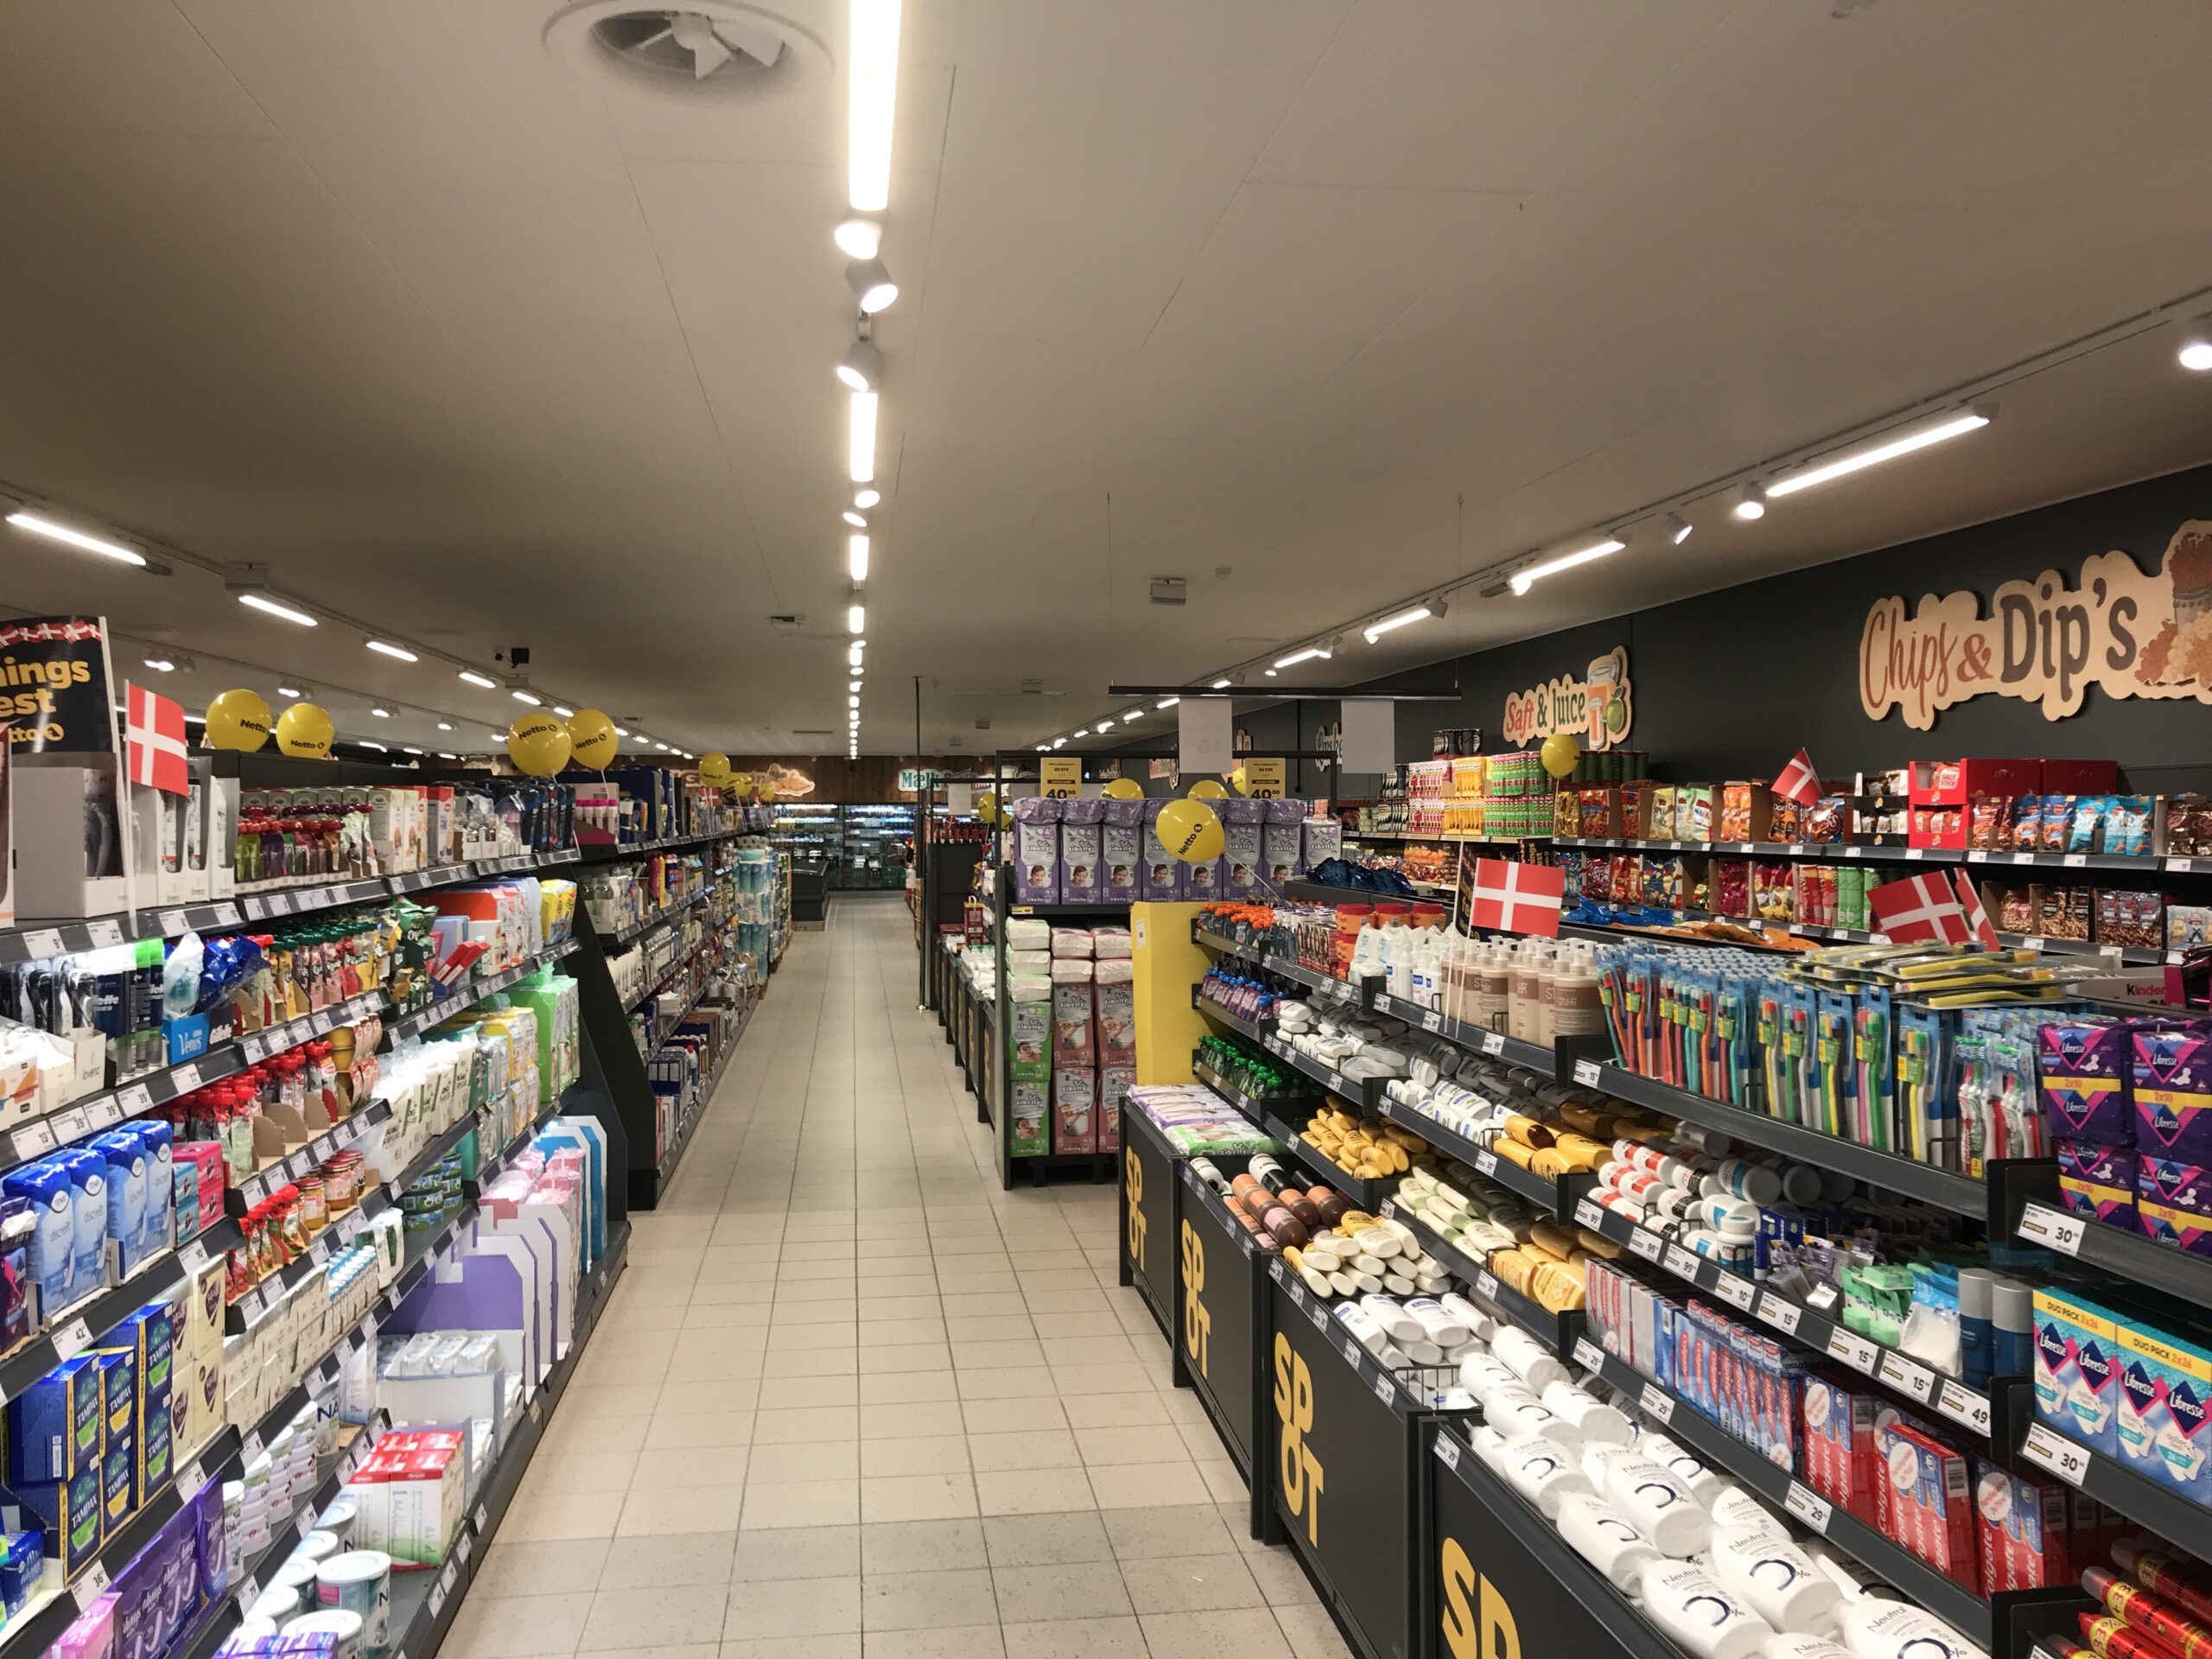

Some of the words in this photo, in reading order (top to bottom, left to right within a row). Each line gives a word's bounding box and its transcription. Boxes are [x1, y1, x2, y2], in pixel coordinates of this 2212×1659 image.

[1865, 607, 1958, 718] Chips
[1956, 632, 1993, 683] &
[1999, 577, 2138, 702] Dip's
[0, 657, 90, 689] ings
[1507, 698, 1534, 738] Saft
[1537, 693, 1547, 728] &
[1551, 684, 1586, 734] Juice
[240, 719, 267, 734] Netto
[518, 725, 547, 740] Netto
[10, 727, 41, 743] tto
[575, 736, 599, 750] Netto
[290, 740, 315, 749] Netto
[1046, 789, 1067, 799] 40
[1250, 789, 1272, 799] 40
[1178, 832, 1198, 855] Netto
[2126, 983, 2165, 995] Kinder
[179, 1033, 201, 1055] Venus
[2062, 1043, 2085, 1053] Libresse
[2152, 1054, 2177, 1066] Libresse
[2066, 1102, 2088, 1113] Libresse
[2155, 1116, 2179, 1129] Libresse
[2158, 1168, 2182, 1185] Libresse
[2056, 1227, 2072, 1243] 30
[1783, 1313, 1793, 1325] 15
[2048, 1301, 2062, 1314] DUO
[2063, 1308, 2081, 1322] PACK
[2081, 1315, 2100, 1330] 2x26
[76, 1328, 86, 1340] 42
[2039, 1332, 2067, 1357] Libresse
[1859, 1350, 1869, 1363] 15
[2133, 1338, 2149, 1351] DUO
[2150, 1344, 2171, 1359] PACK
[2171, 1354, 2192, 1369] 2x26
[2079, 1350, 2110, 1376] Libresse
[1913, 1376, 1925, 1392] 15
[2124, 1371, 2155, 1397] Libresse
[2171, 1392, 2204, 1419] Libresse
[1973, 1408, 1987, 1424] 49
[2060, 1453, 2077, 1471] 30
[1811, 1507, 1823, 1522] 29
[1728, 1532, 1769, 1552] Neutral
[92, 1574, 105, 1588] 36
[1662, 1568, 1702, 1586] Neutral
[1866, 1605, 1908, 1632] Neutral
[1794, 1641, 1836, 1655] Neutral
